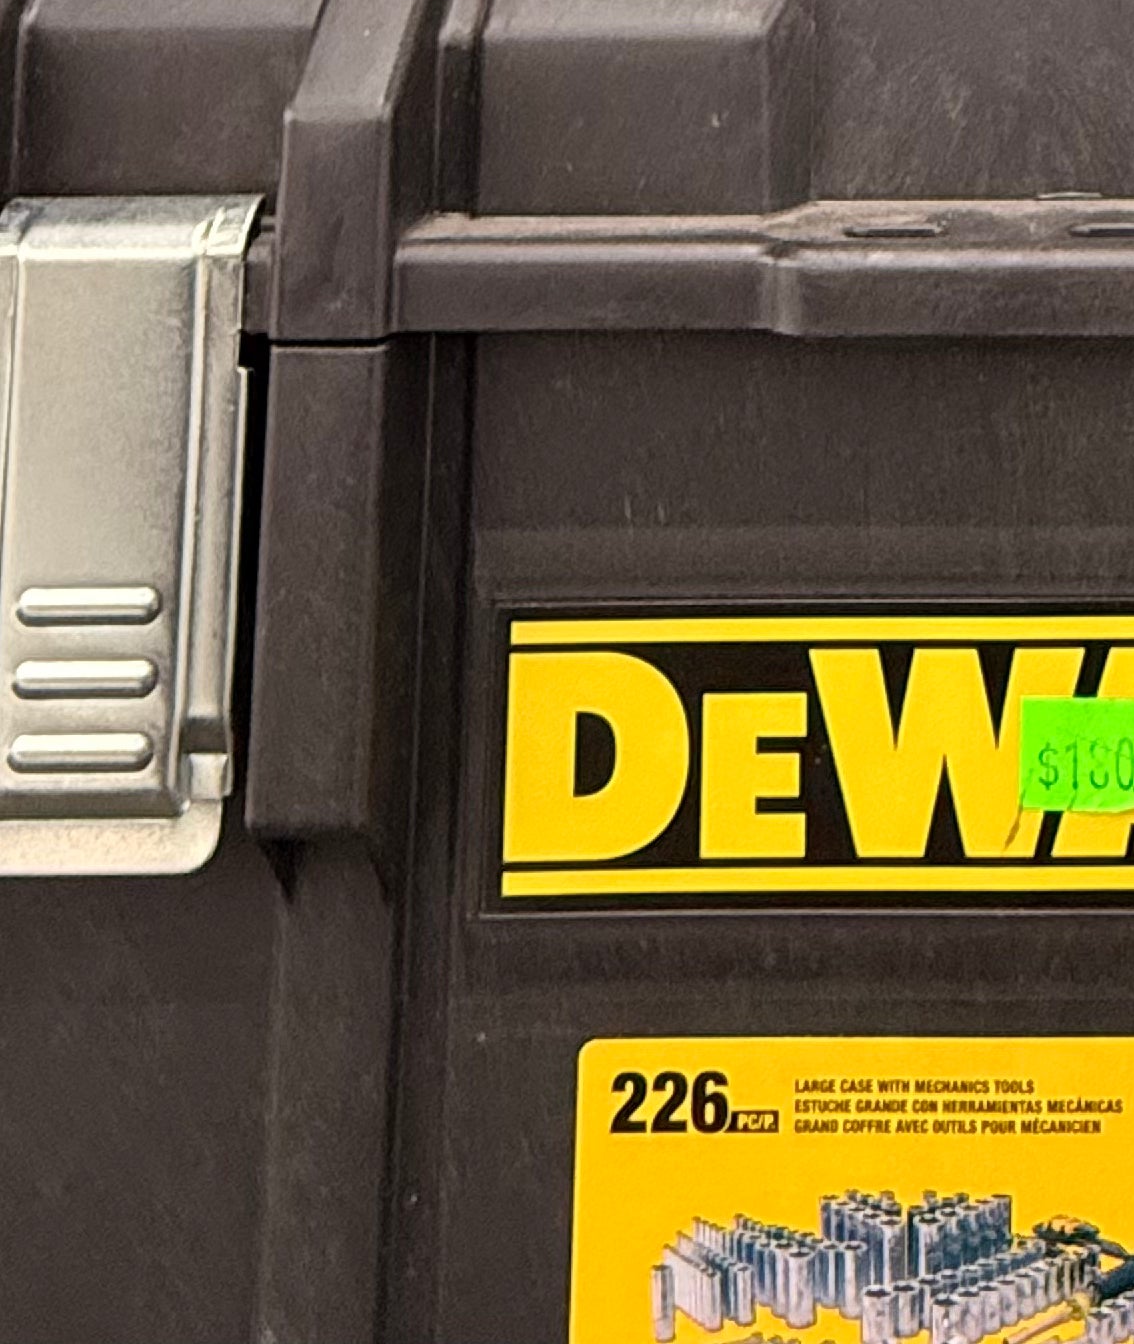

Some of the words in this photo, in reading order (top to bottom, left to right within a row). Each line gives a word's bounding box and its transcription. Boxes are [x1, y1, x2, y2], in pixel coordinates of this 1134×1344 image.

[795, 1079, 836, 1093] LARGE
[840, 1079, 872, 1093] CASE
[877, 1079, 910, 1093] WITH
[915, 1079, 990, 1093] MECHANICS
[994, 1079, 1034, 1094] TOOLS
[610, 1071, 728, 1133] 226
[795, 1099, 851, 1113] ESTUCHE
[856, 1099, 907, 1113] GRANDE
[912, 1099, 938, 1113] CON
[942, 1099, 1043, 1114] HERRAMIENTAS
[795, 1119, 838, 1134] GRAND
[843, 1119, 891, 1134] COFFRE
[895, 1119, 929, 1133] AVEC
[932, 1119, 977, 1134] OUTILS
[981, 1119, 1016, 1134] POUR
[1021, 1117, 1101, 1134] MÉCANICIEN
